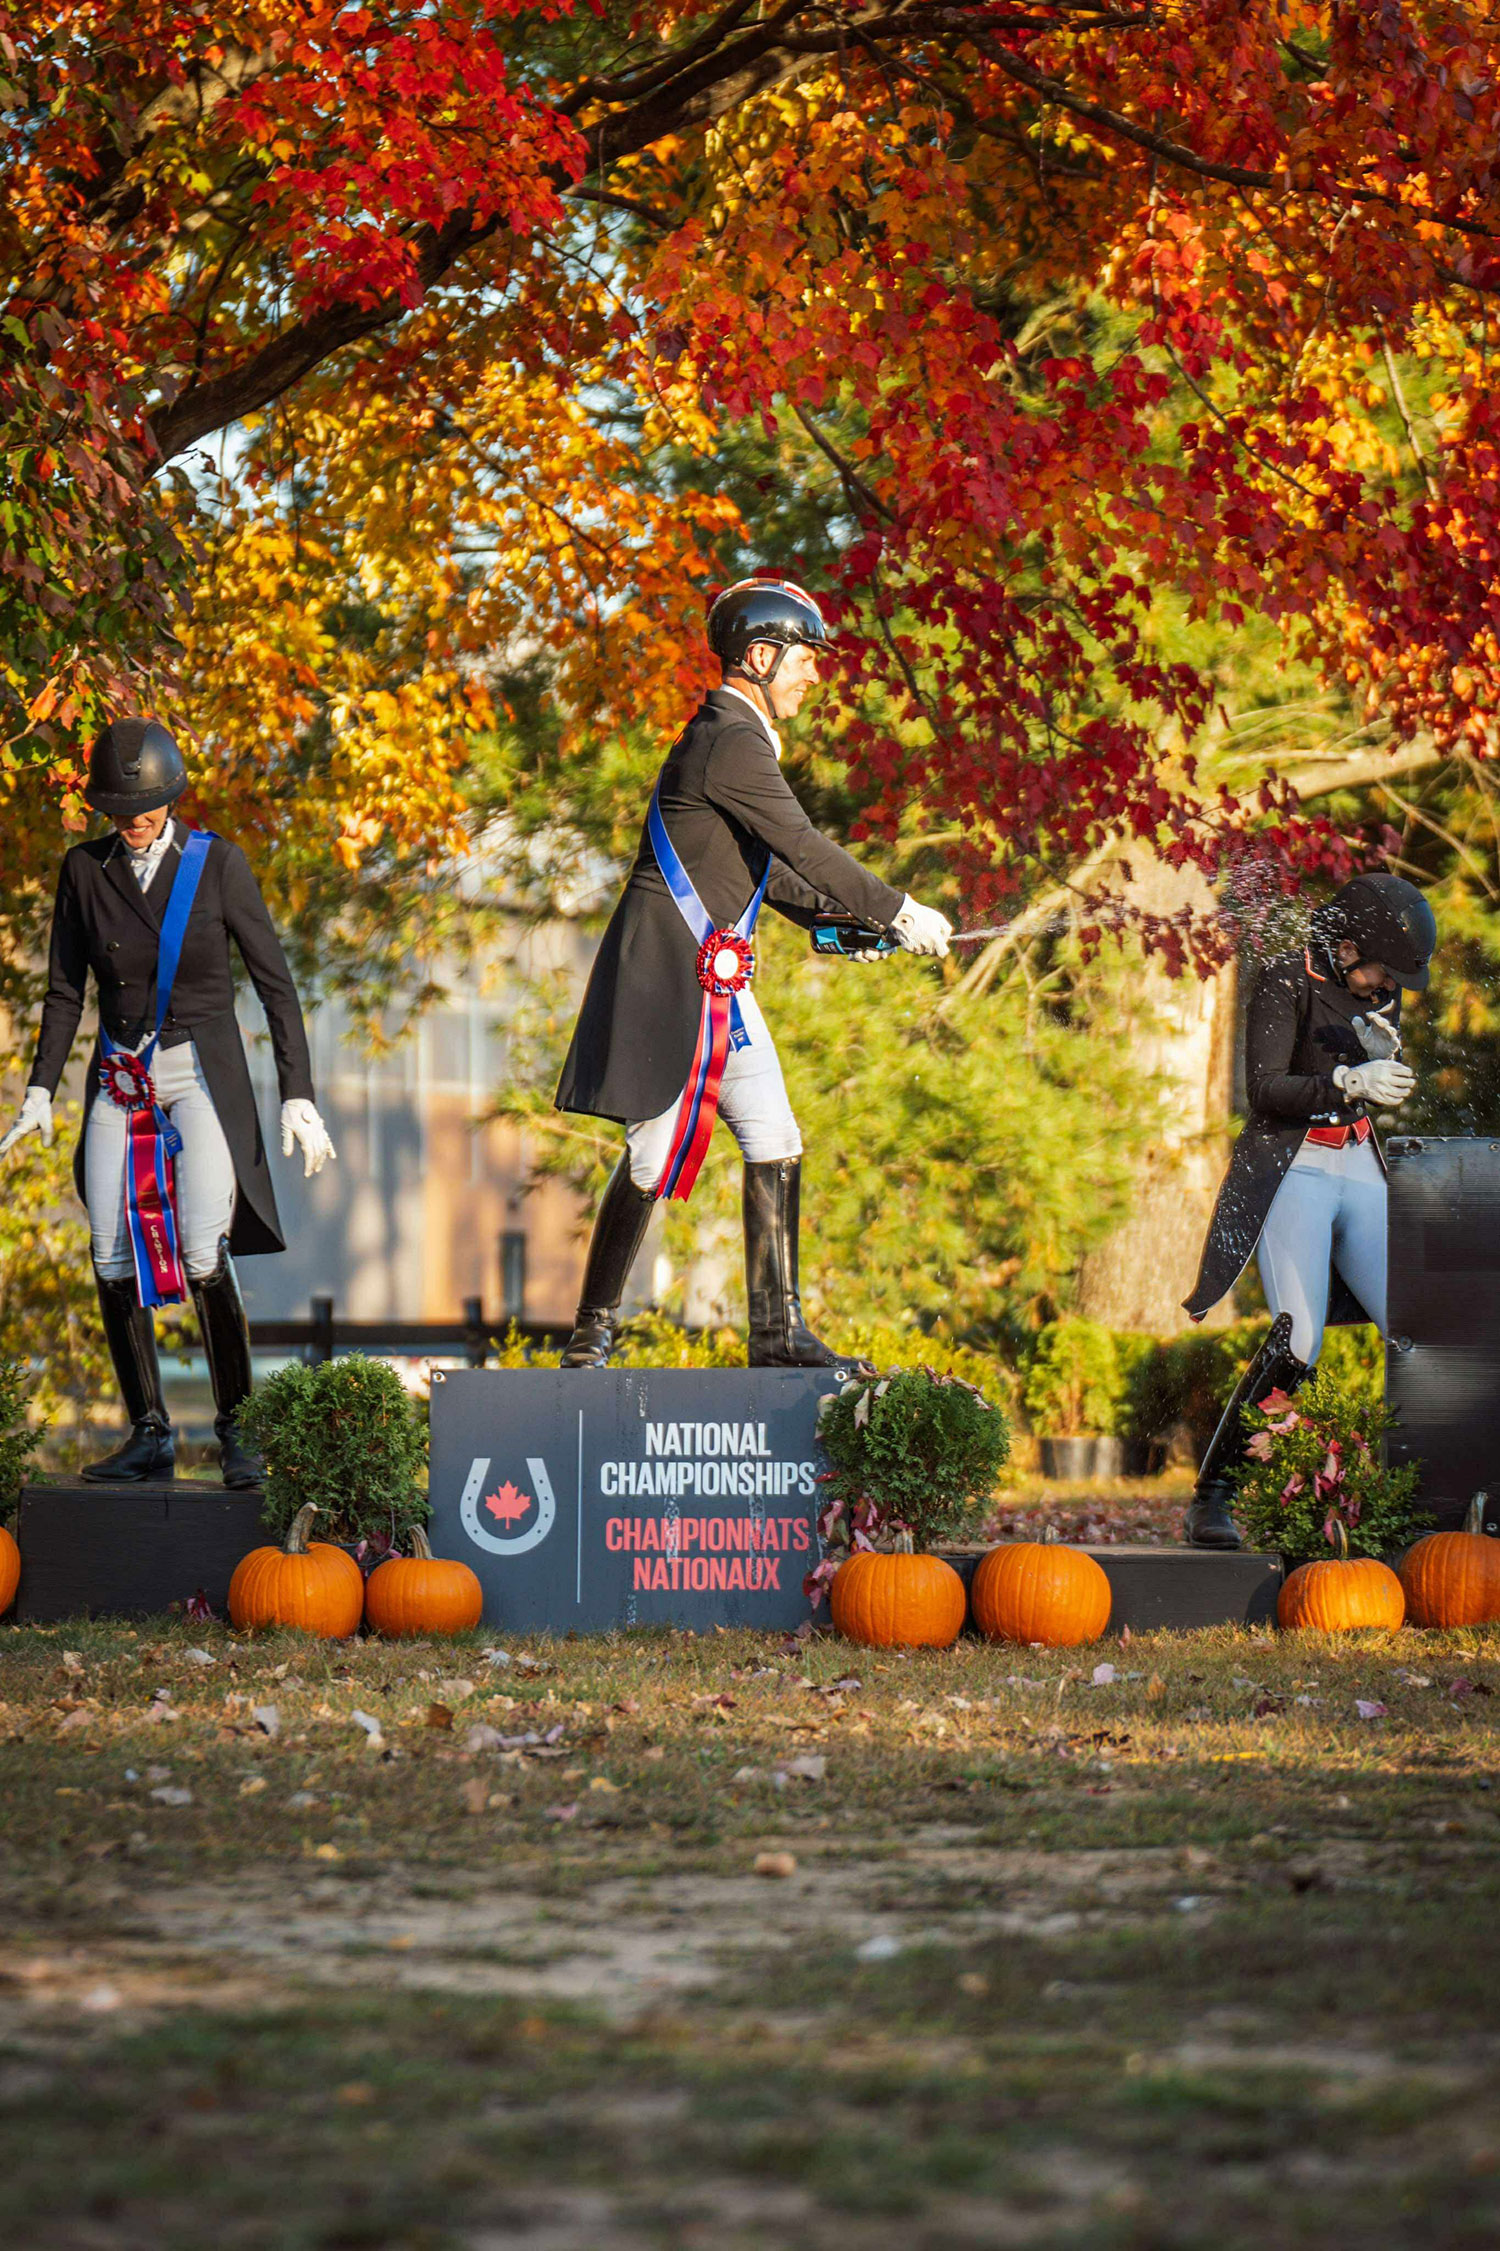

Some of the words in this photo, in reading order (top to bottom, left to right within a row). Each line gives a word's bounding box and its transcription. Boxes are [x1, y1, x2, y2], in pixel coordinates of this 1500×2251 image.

[645, 1422, 772, 1456] NATIONAL
[600, 1461, 816, 1495] CHAMPIONSHIPS
[605, 1517, 810, 1551] CHAMPIONNATS
[633, 1557, 781, 1590] NATIONAUX
